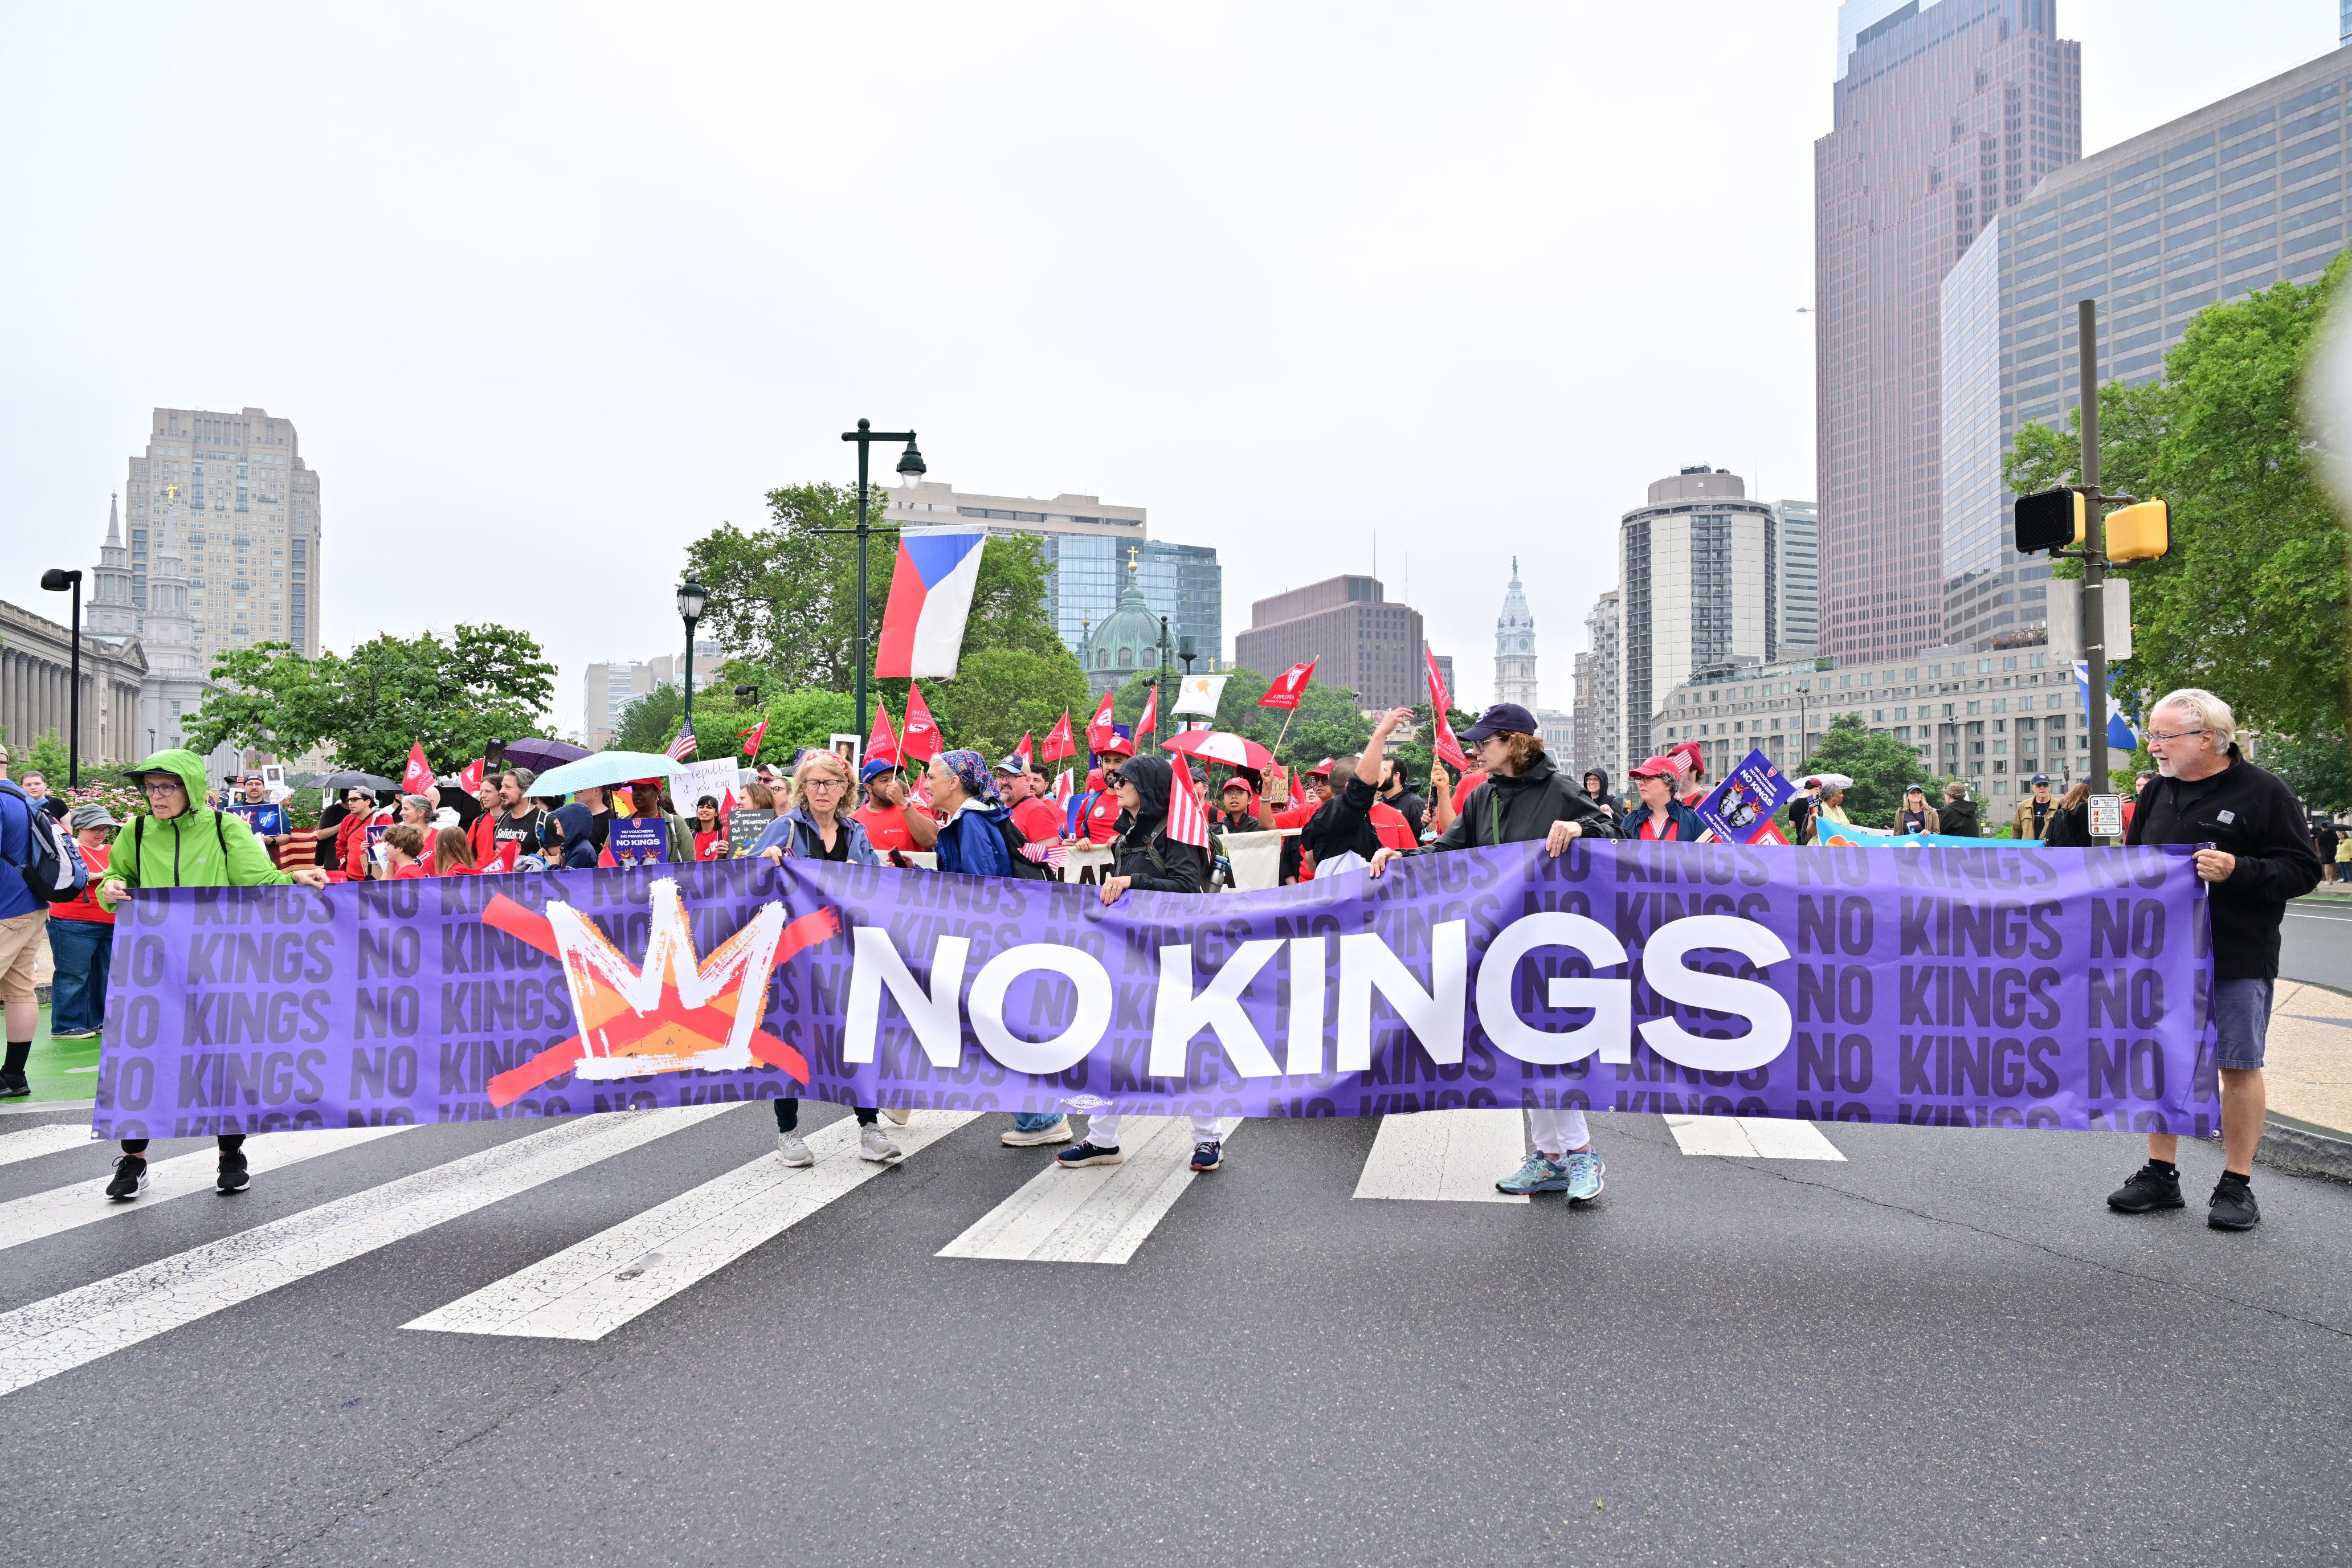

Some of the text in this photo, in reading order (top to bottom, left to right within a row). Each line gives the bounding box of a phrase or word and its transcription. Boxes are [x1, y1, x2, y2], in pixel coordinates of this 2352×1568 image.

[675, 773, 682, 784] A
[684, 779, 730, 797] if you can
[1740, 769, 1774, 807] NO KINGS
[1754, 774, 1775, 797] PRIVATEERS
[1758, 771, 1777, 792] VOUCHERS
[1705, 814, 1732, 842] PHILADELPHIA
[193, 885, 335, 926] KINGS
[358, 879, 419, 920] NO
[816, 862, 881, 901] NO
[896, 868, 1030, 918] KINGS
[1522, 839, 1591, 883] NO
[1615, 840, 1770, 887] KINGS
[1795, 846, 1870, 886] NO
[1892, 847, 2058, 892] KINGS
[2084, 846, 2167, 890] NO
[187, 929, 335, 985] KINGS
[357, 926, 420, 980] NO
[442, 922, 562, 975] KING
[1797, 894, 1874, 956] NO
[1900, 895, 2063, 961] KINGS
[2089, 897, 2165, 959] NO
[182, 989, 331, 1047] KINGS
[353, 985, 420, 1040] NO
[440, 975, 571, 1035] KINGS
[1797, 963, 1873, 1025] NO
[1899, 965, 2061, 1030] KINGS
[2088, 967, 2164, 1030] NO
[843, 926, 1113, 1074] NO
[1149, 912, 1792, 1078] KINGS
[177, 1048, 327, 1109] KINGS
[349, 1046, 418, 1101] NO
[1796, 1031, 1873, 1094] NO
[1899, 1034, 2061, 1099] KINGS
[2088, 1038, 2165, 1101] NO
